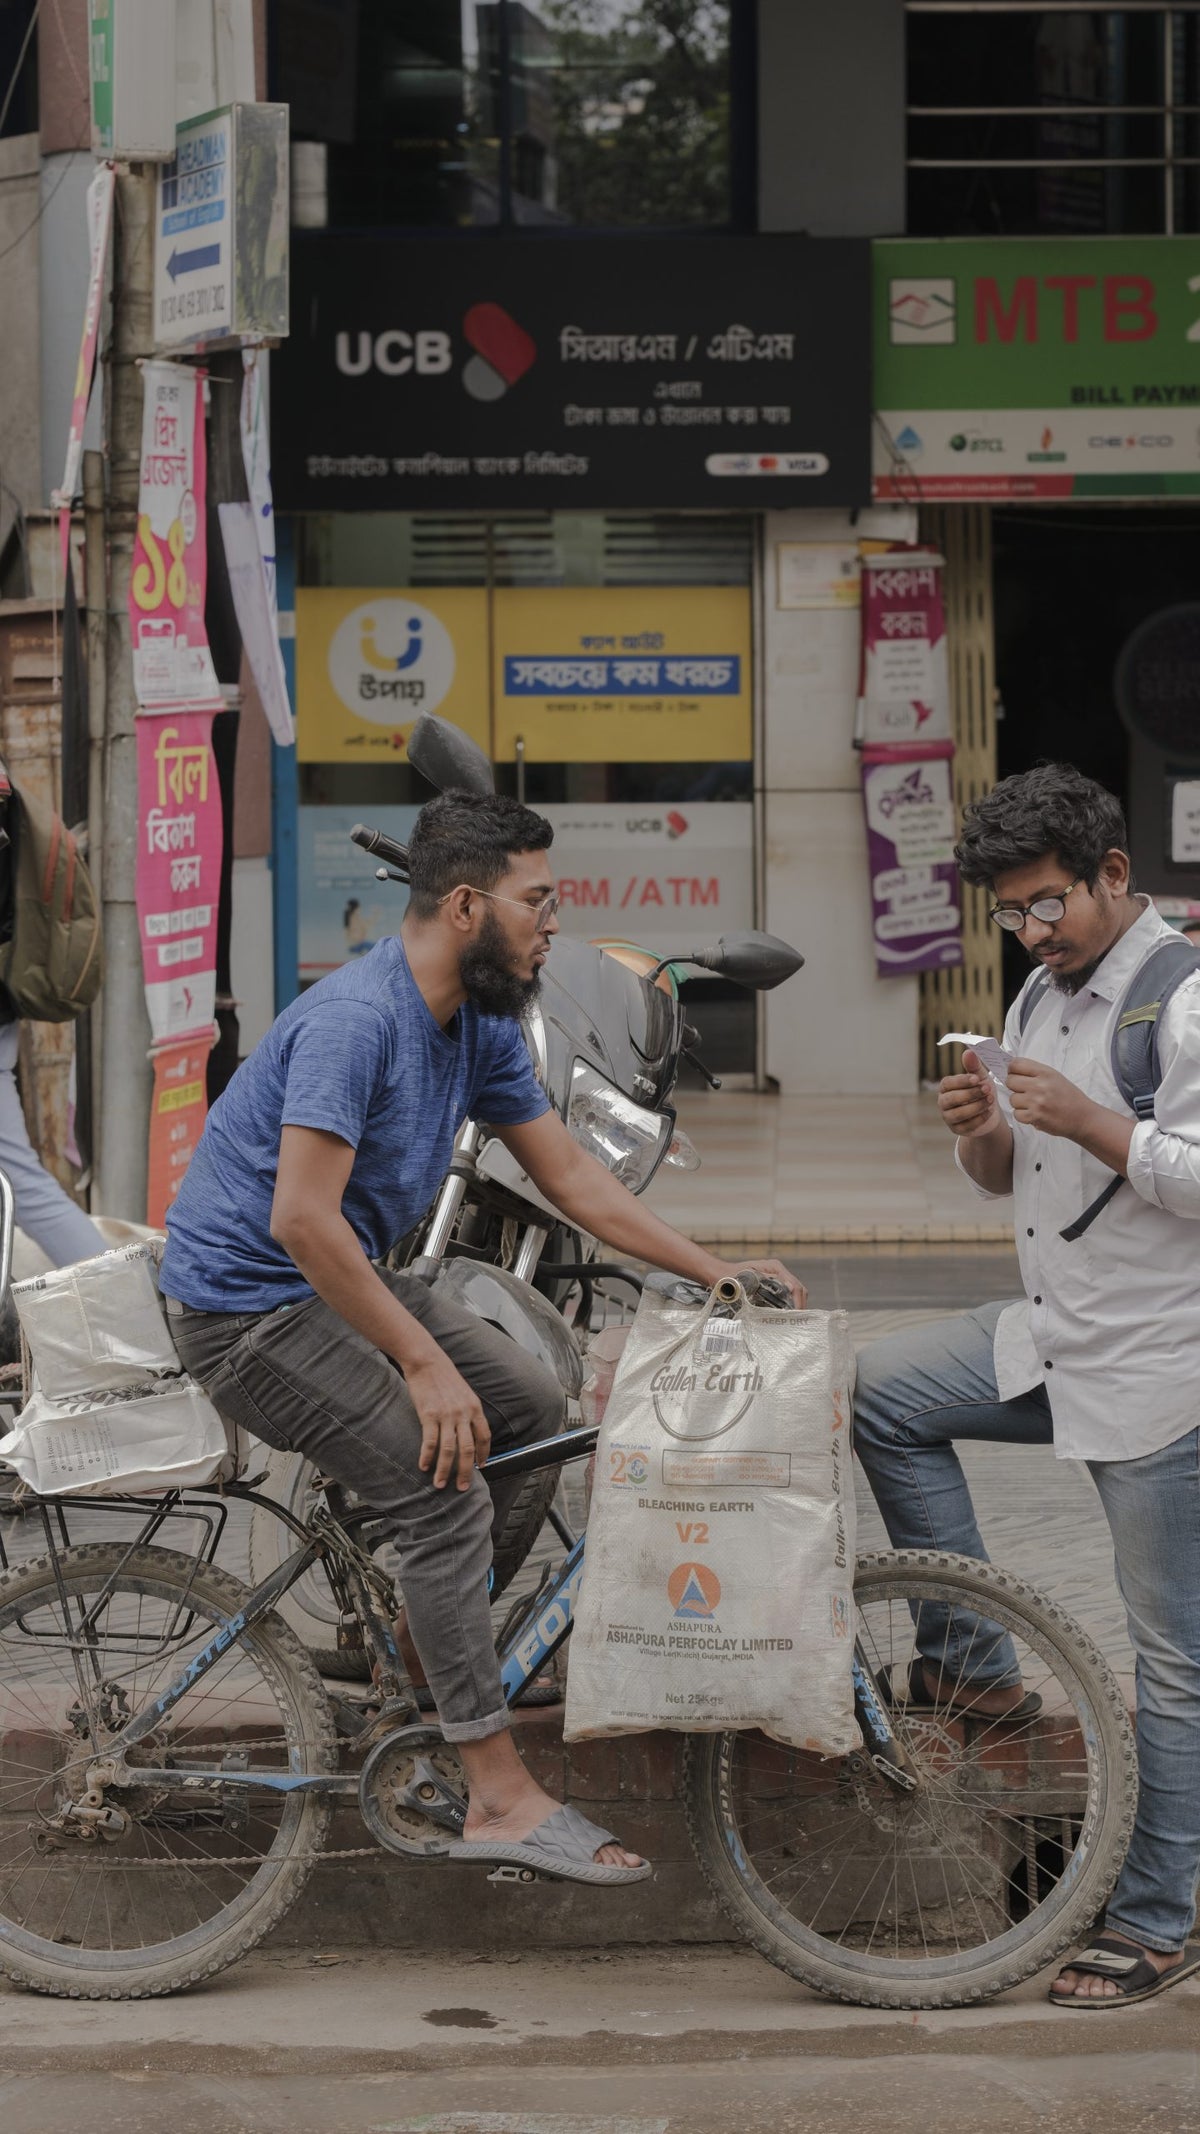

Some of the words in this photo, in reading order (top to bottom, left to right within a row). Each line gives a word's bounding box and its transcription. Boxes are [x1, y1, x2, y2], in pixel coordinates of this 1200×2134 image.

[974, 274, 1159, 344] MTB
[335, 330, 452, 376] UCB
[558, 324, 679, 363] সিআরএম
[705, 324, 796, 362] এটিএম
[1071, 385, 1125, 404] BILL
[512, 661, 608, 688] সবচেয়ে
[613, 661, 660, 686] কম
[665, 661, 733, 687] খরচে
[357, 673, 427, 707] উপায়
[154, 727, 209, 807] বিল
[145, 807, 196, 854] বিকাশ
[624, 817, 664, 834] UCB
[558, 877, 611, 908] RM
[632, 1073, 658, 1096] TVS
[761, 1316, 787, 1326] KEEP
[789, 1316, 809, 1326] DRY
[704, 1364, 765, 1393] Earth
[638, 1498, 706, 1513] BLEACHING
[709, 1502, 755, 1513] EARTH
[675, 1521, 710, 1544] V2
[606, 1630, 666, 1648] ASHAPURA
[669, 1635, 737, 1651] PERFOCLAY
[742, 1638, 794, 1652] LIMITED
[667, 1621, 723, 1634] ASHAPURA
[156, 1613, 247, 1713] FOXTER
[665, 1693, 685, 1704] Net
